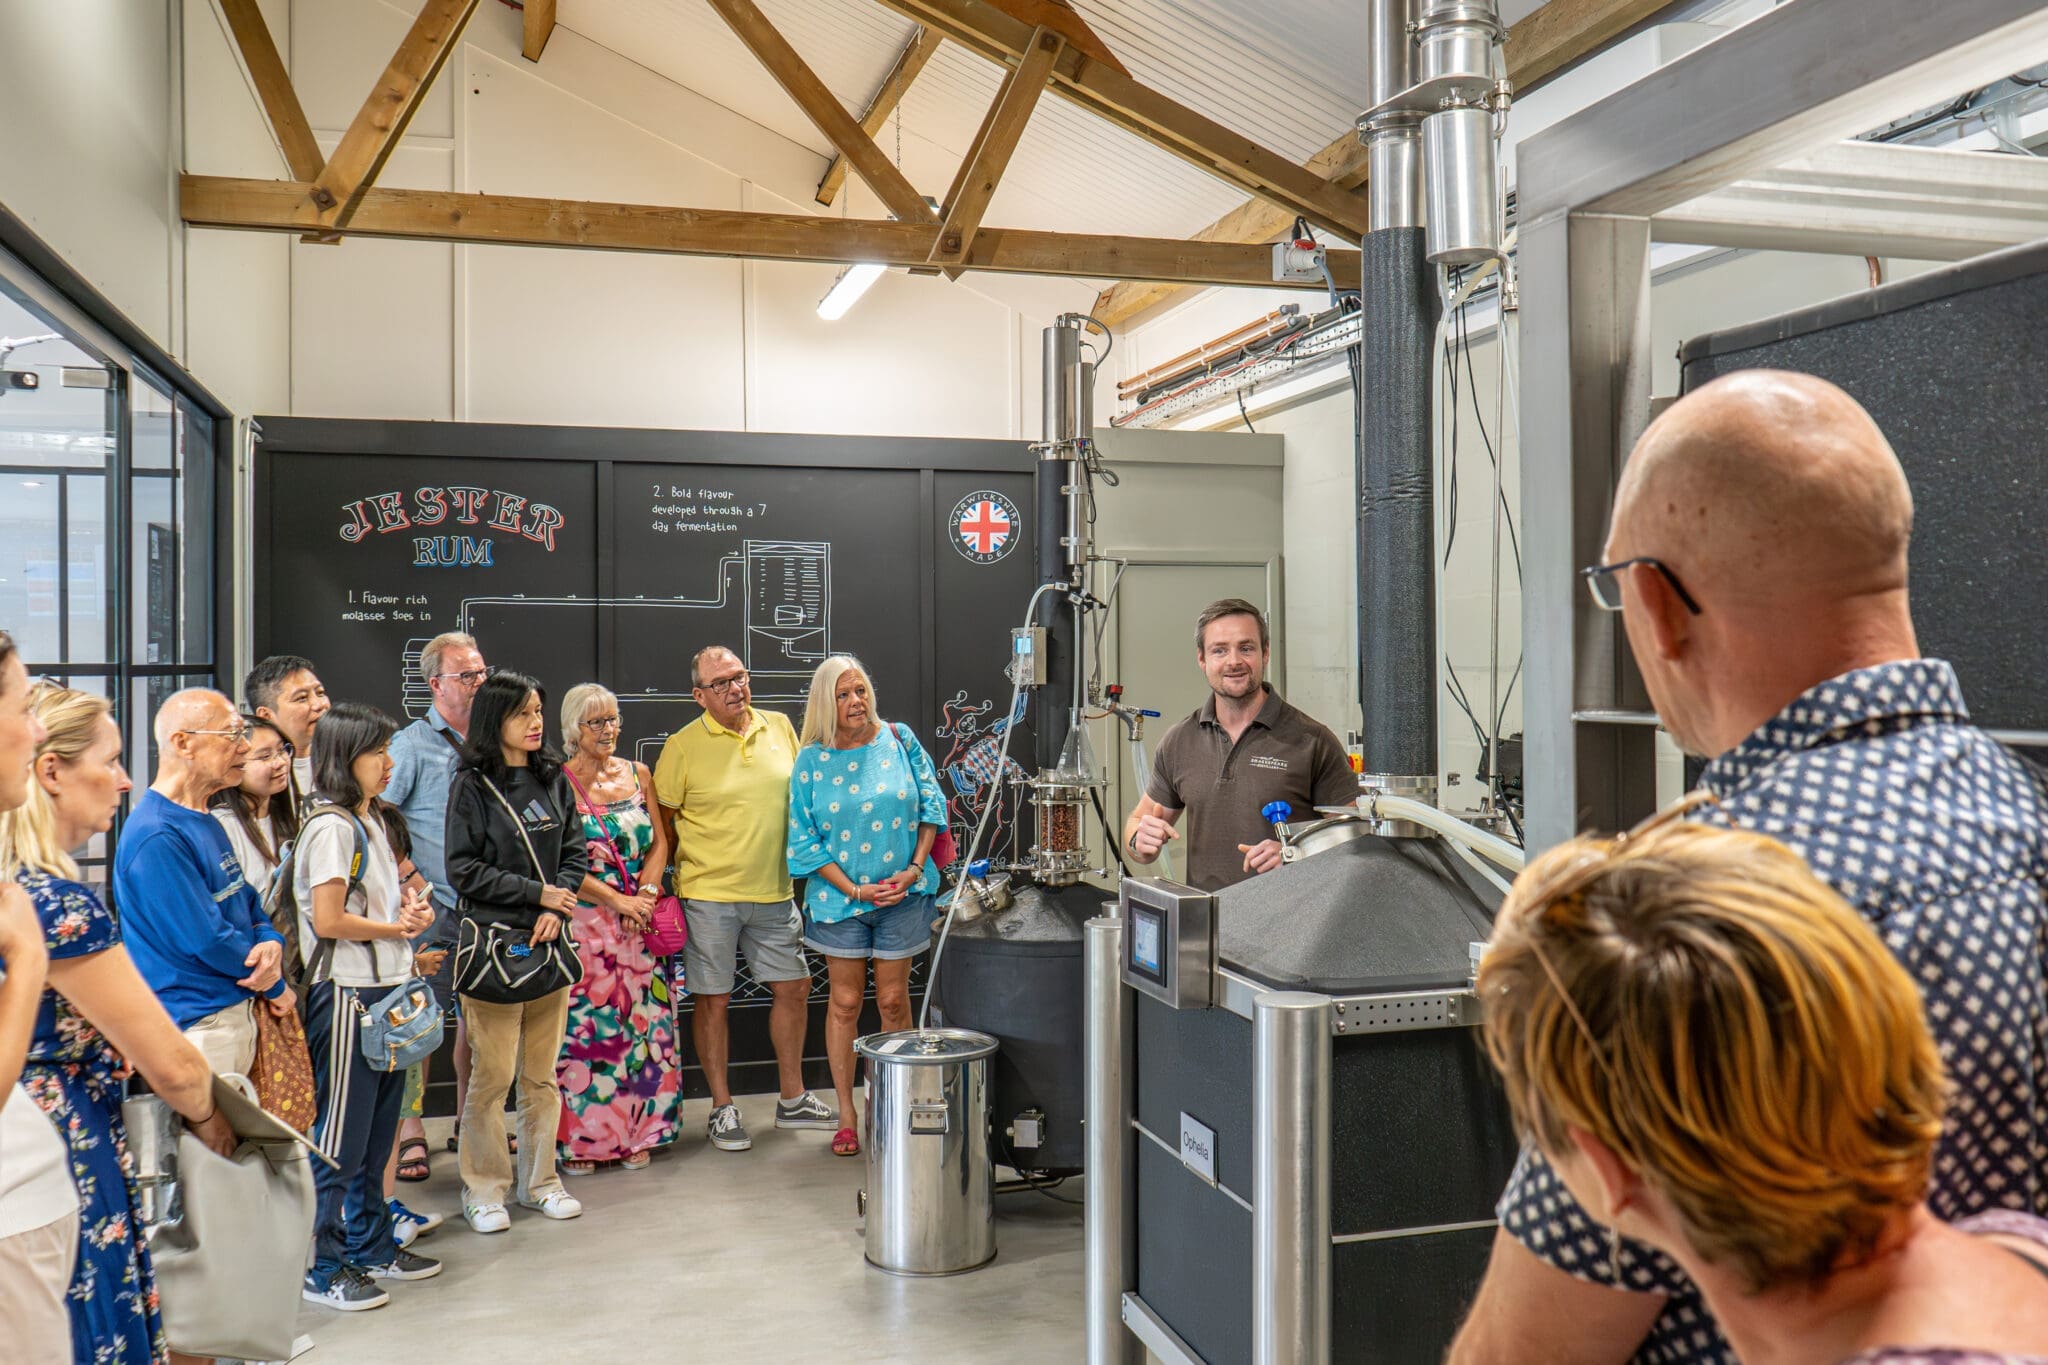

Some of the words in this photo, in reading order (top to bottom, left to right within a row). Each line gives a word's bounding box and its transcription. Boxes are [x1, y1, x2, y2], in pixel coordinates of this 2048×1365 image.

[653, 485, 664, 498] 2.
[671, 486, 692, 498] Bold
[698, 489, 734, 500] flavour
[652, 505, 697, 519] developed
[703, 505, 742, 516] through
[746, 507, 754, 517] a
[758, 503, 767, 516] 7
[951, 493, 1019, 527] WARWICKSHIRE
[340, 487, 564, 552] JESTER
[652, 520, 669, 533] day
[676, 521, 738, 533] fermentation
[413, 535, 494, 567] RUM
[966, 550, 1003, 561] MADE
[363, 591, 399, 605] Flavour
[406, 594, 428, 605] rich
[342, 611, 386, 622] molasses
[393, 611, 414, 621] goes
[420, 611, 432, 621] in
[1183, 1131, 1209, 1161] Ophelia
